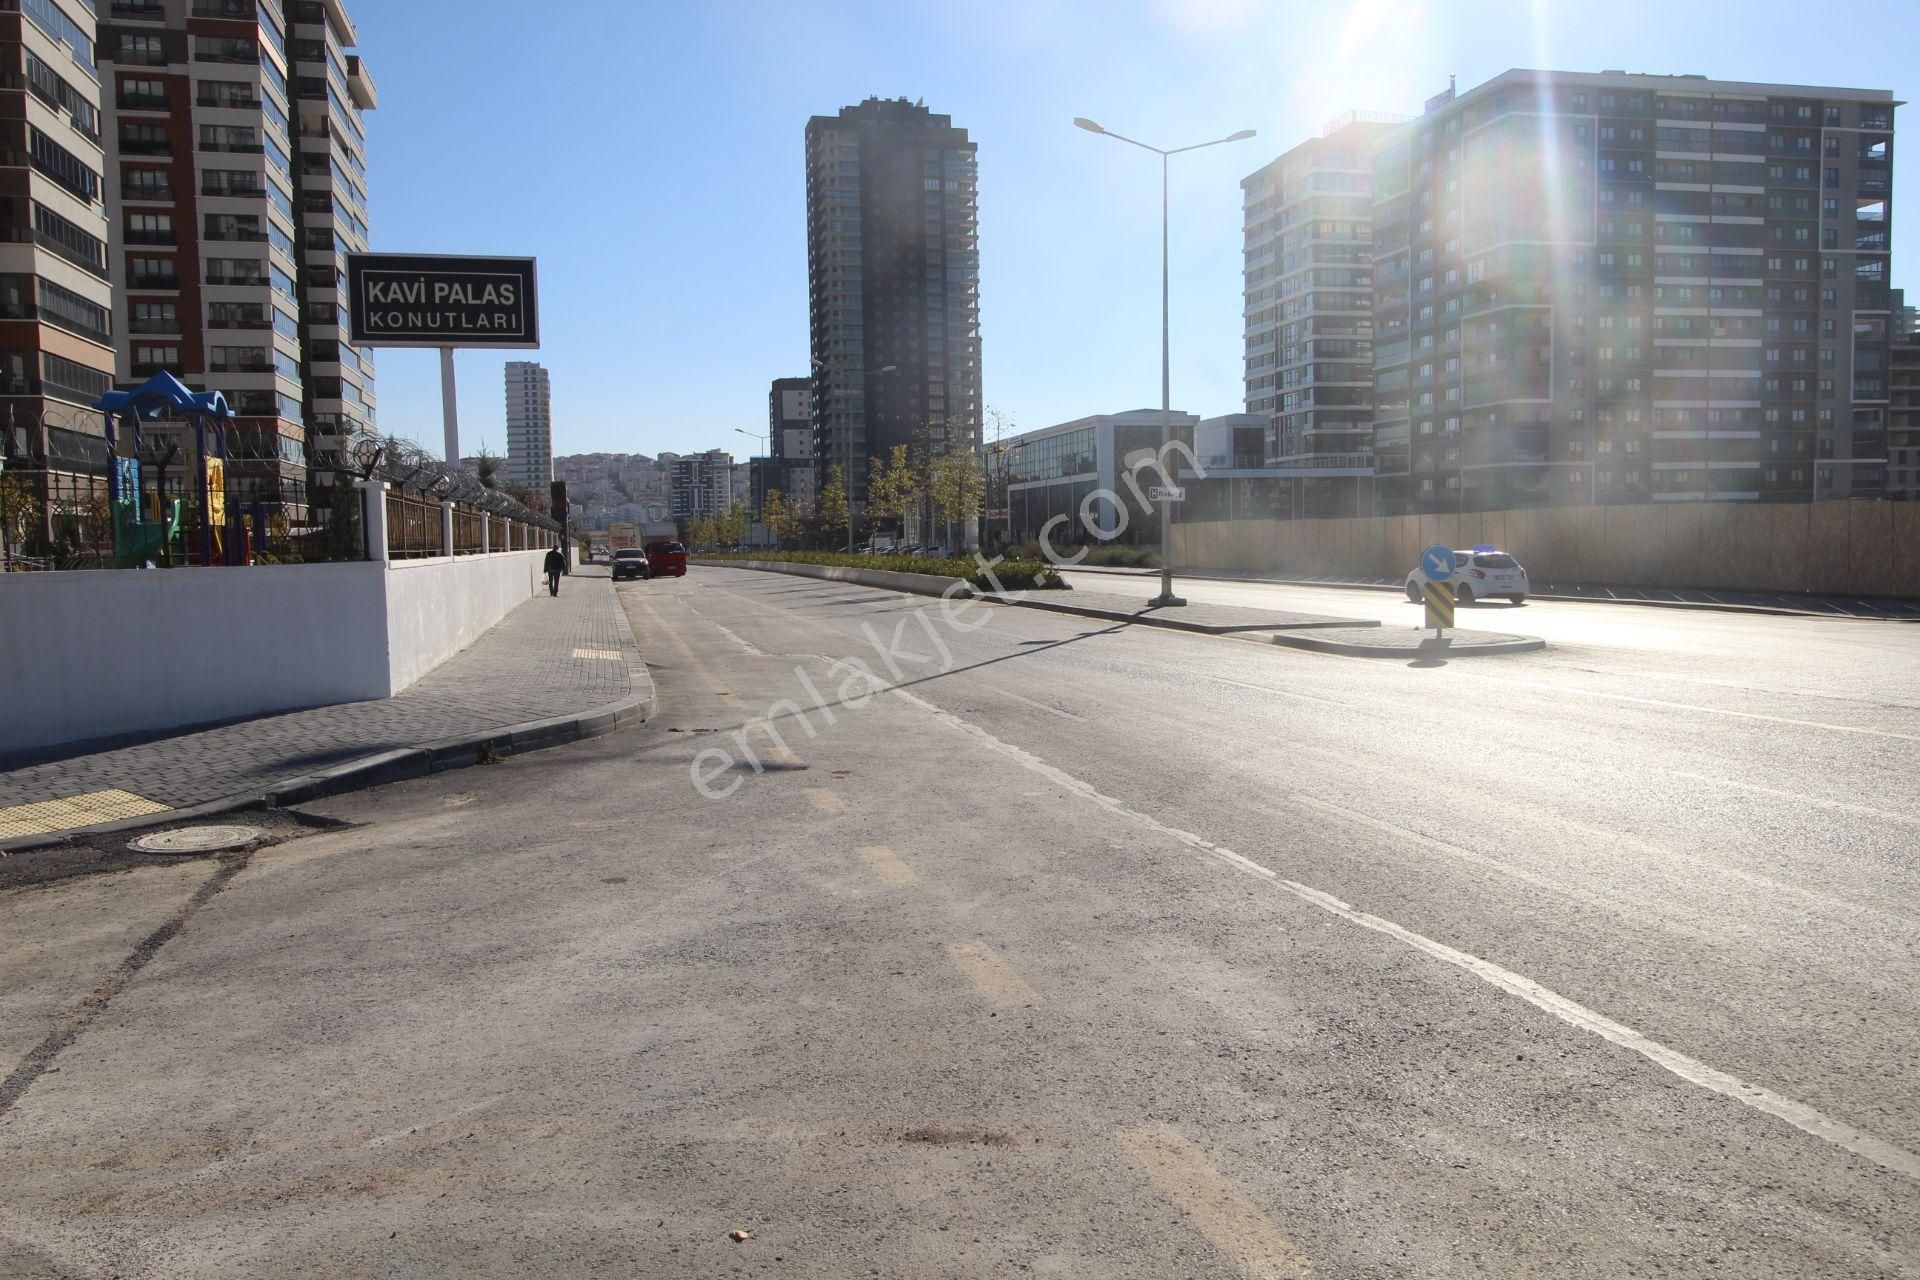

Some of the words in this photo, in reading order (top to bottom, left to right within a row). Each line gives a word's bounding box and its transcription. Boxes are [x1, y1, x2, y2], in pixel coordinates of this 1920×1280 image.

[368, 277, 426, 304] KAVİ
[434, 282, 515, 305] PALAS
[370, 311, 517, 329] KONUTLARI
